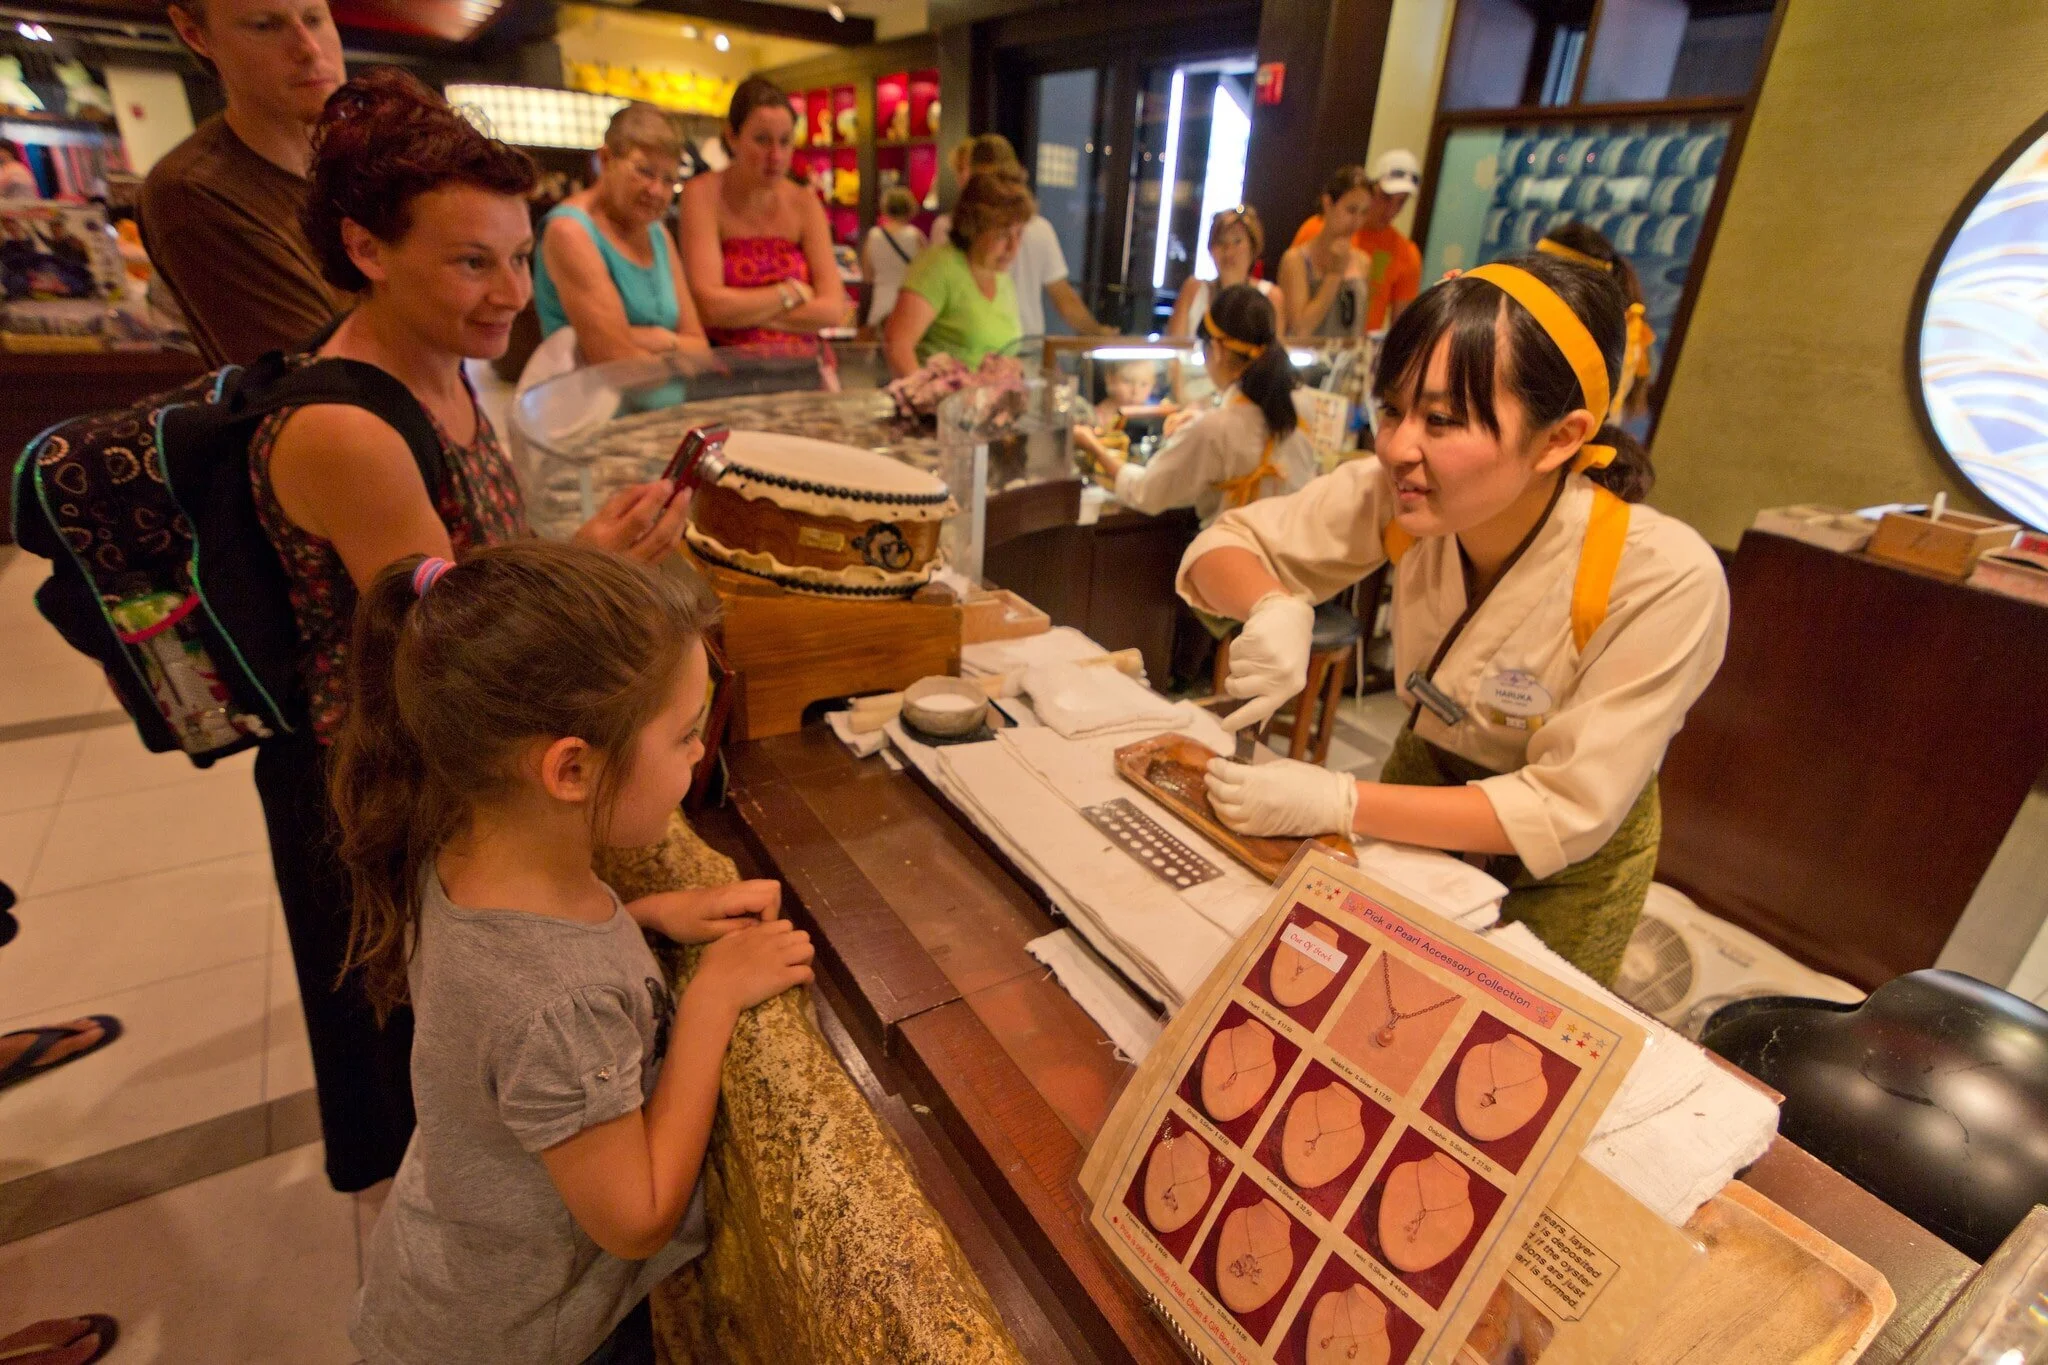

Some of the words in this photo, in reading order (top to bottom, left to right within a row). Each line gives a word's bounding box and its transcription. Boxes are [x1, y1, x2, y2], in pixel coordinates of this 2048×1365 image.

[1290, 933, 1303, 944] Out
[1364, 908, 1385, 926] Pick
[1385, 922, 1393, 931] a
[1394, 925, 1421, 945] Pearl
[1421, 942, 1475, 977] Accessory
[1477, 972, 1531, 1009] Collection
[1540, 1226, 1551, 1237] is
[1551, 1236, 1602, 1279] deposited
[1543, 1245, 1560, 1261] the
[1560, 1260, 1594, 1287] oyster
[1569, 1235, 1595, 1257] layer
[1521, 1241, 1547, 1265] tions
[1547, 1265, 1564, 1280] are
[1561, 1278, 1586, 1298] just
[1530, 1264, 1541, 1276] is
[1540, 1273, 1579, 1310] formed.
[1208, 1320, 1221, 1336] Gift
[1219, 1332, 1231, 1347] Box
